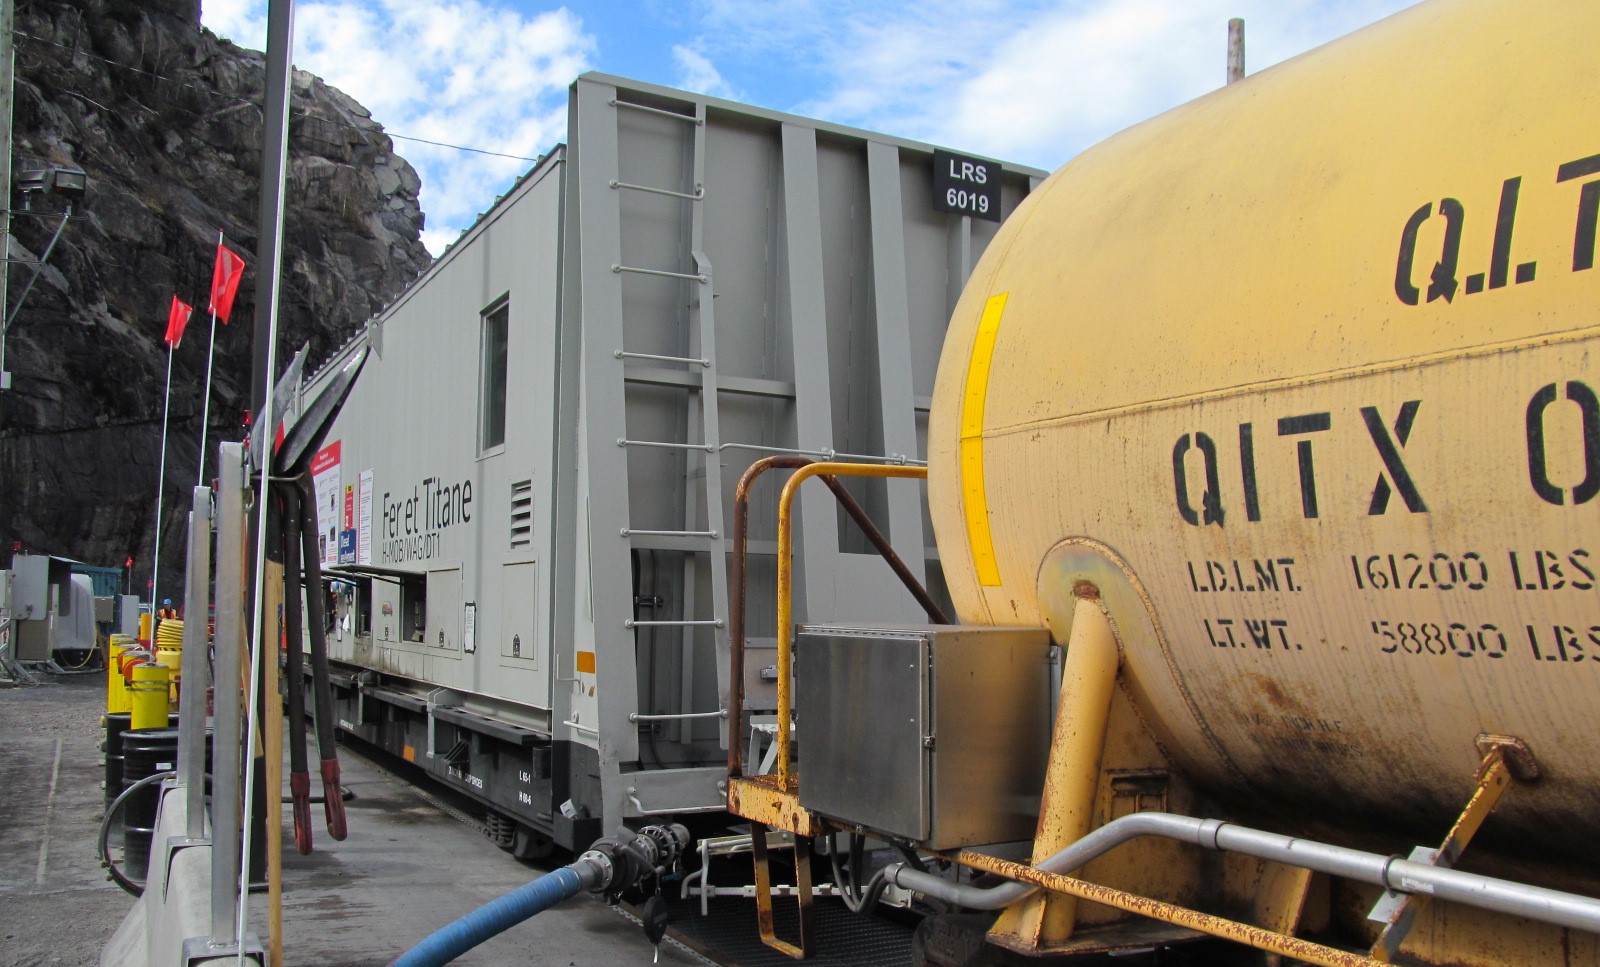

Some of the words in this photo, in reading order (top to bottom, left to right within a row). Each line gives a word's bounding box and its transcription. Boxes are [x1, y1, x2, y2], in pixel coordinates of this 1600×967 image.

[949, 158, 987, 184] LRS
[946, 188, 989, 213] 6019
[1173, 400, 1428, 529] QITX
[382, 492, 402, 539] Fer
[405, 485, 419, 535] et
[423, 476, 472, 530] Titane
[1351, 551, 1489, 591] 161200
[1509, 549, 1596, 591] LBS
[1371, 621, 1508, 659] 58800
